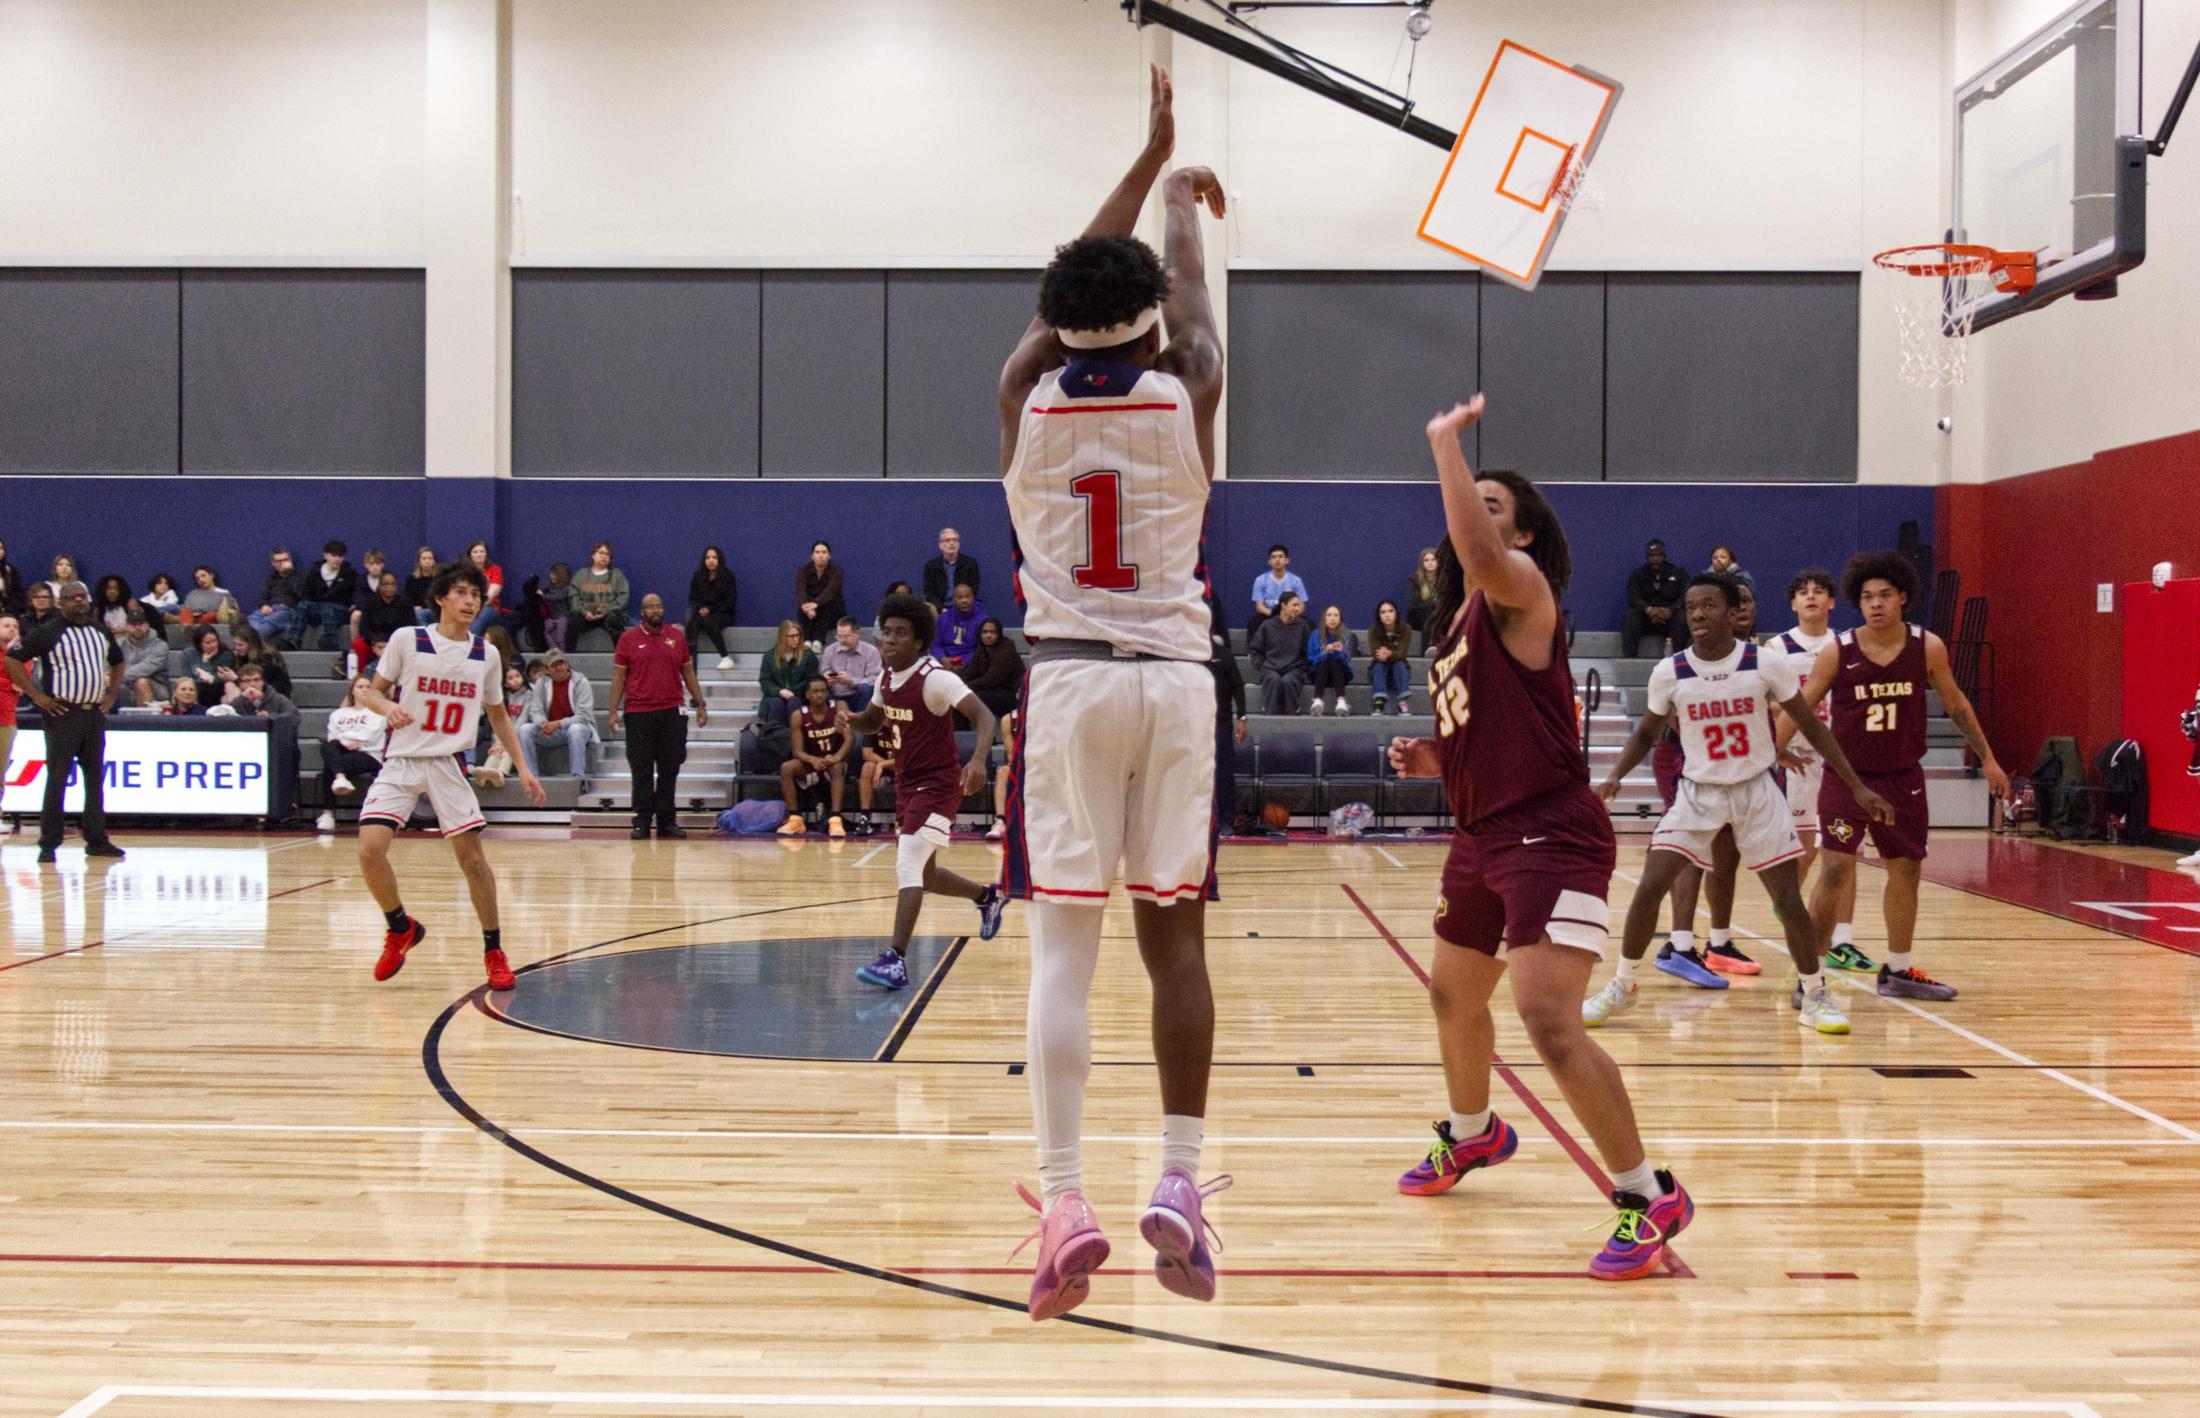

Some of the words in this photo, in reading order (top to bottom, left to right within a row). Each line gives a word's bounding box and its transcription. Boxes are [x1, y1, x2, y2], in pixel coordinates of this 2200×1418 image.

[1070, 470, 1139, 592] 1
[417, 676, 477, 699] EAGLES
[1854, 685, 1868, 700] IL
[1870, 682, 1913, 698] TEXAS
[420, 699, 465, 735] 10
[1436, 675, 1470, 737] 32
[1687, 697, 1755, 721] EAGLES
[1866, 703, 1897, 732] 21
[1703, 721, 1751, 761] 23
[157, 761, 262, 789] PREP
